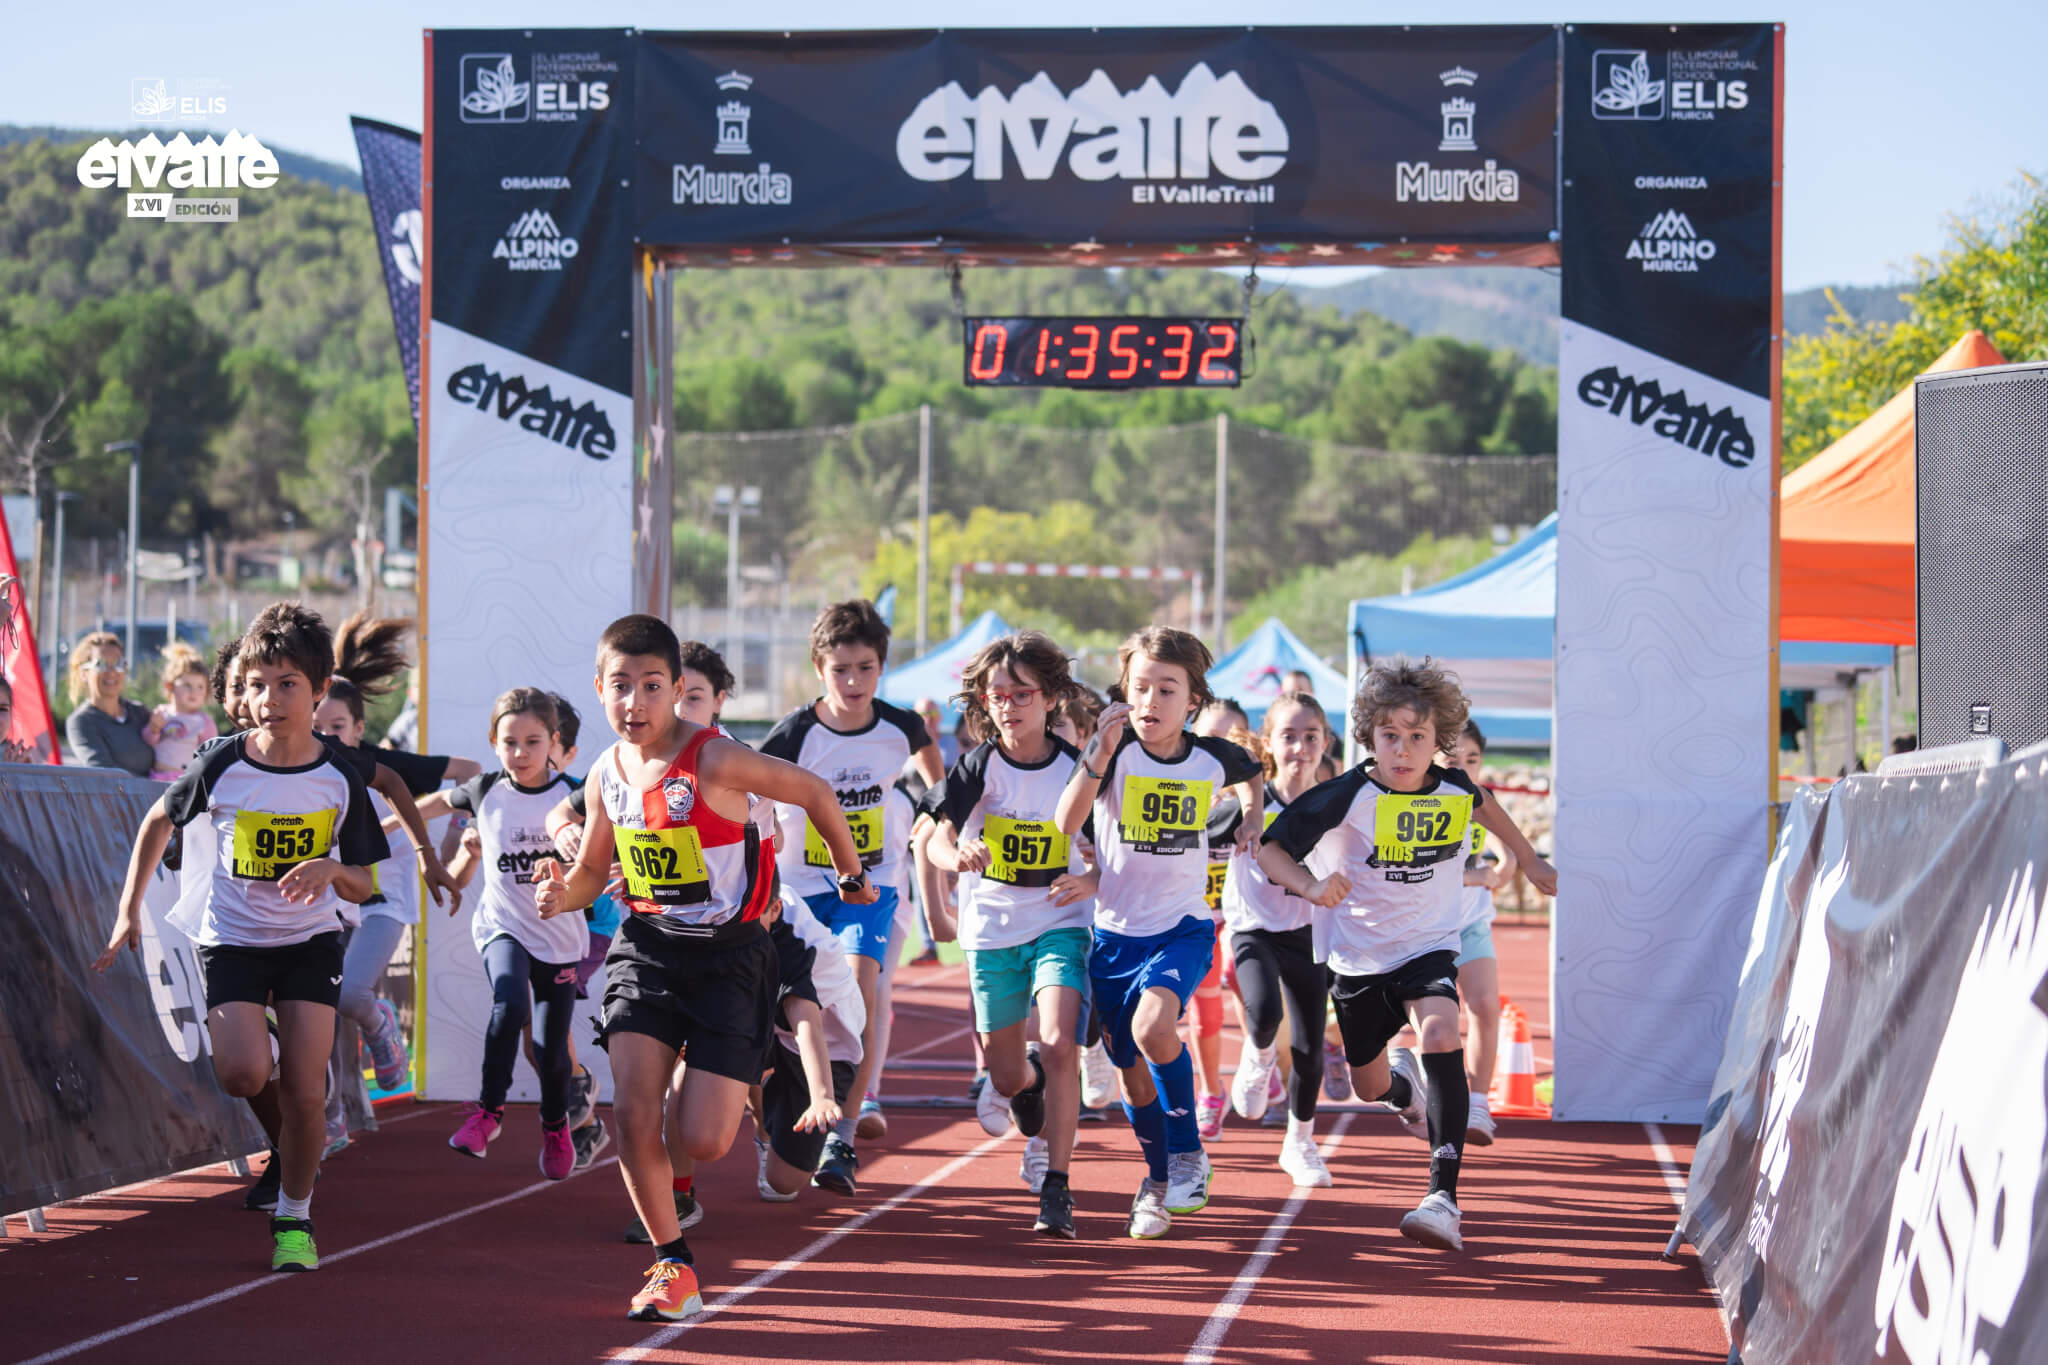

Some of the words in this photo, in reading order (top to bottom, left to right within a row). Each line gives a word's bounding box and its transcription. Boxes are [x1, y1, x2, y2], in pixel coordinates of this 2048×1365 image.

[536, 82, 610, 110] ELIS
[1671, 81, 1749, 109] ELIS
[536, 112, 577, 122] MURCIA
[1671, 111, 1715, 121] MURCIA
[501, 176, 571, 190] ORGANIZA
[673, 163, 792, 205] Murcia
[1396, 159, 1519, 203] Murcia
[1634, 176, 1708, 190] ORGANIZA
[1133, 185, 1154, 203] El
[492, 238, 579, 259] ALPINO
[1625, 239, 1716, 260] ALPINO
[509, 259, 562, 271] MURCIA
[1643, 260, 1698, 272] MURCIA
[1142, 793, 1197, 826] 958
[1123, 825, 1159, 843] KIDS
[1396, 811, 1451, 842] 952
[255, 828, 315, 859] 953
[1002, 834, 1052, 865] 957
[1377, 844, 1414, 863] KIDS
[236, 860, 275, 878] KIDS
[629, 845, 682, 880] 962
[985, 864, 1017, 882] KIDS
[1388, 872, 1402, 880] XVI
[627, 878, 654, 900] KIDS
